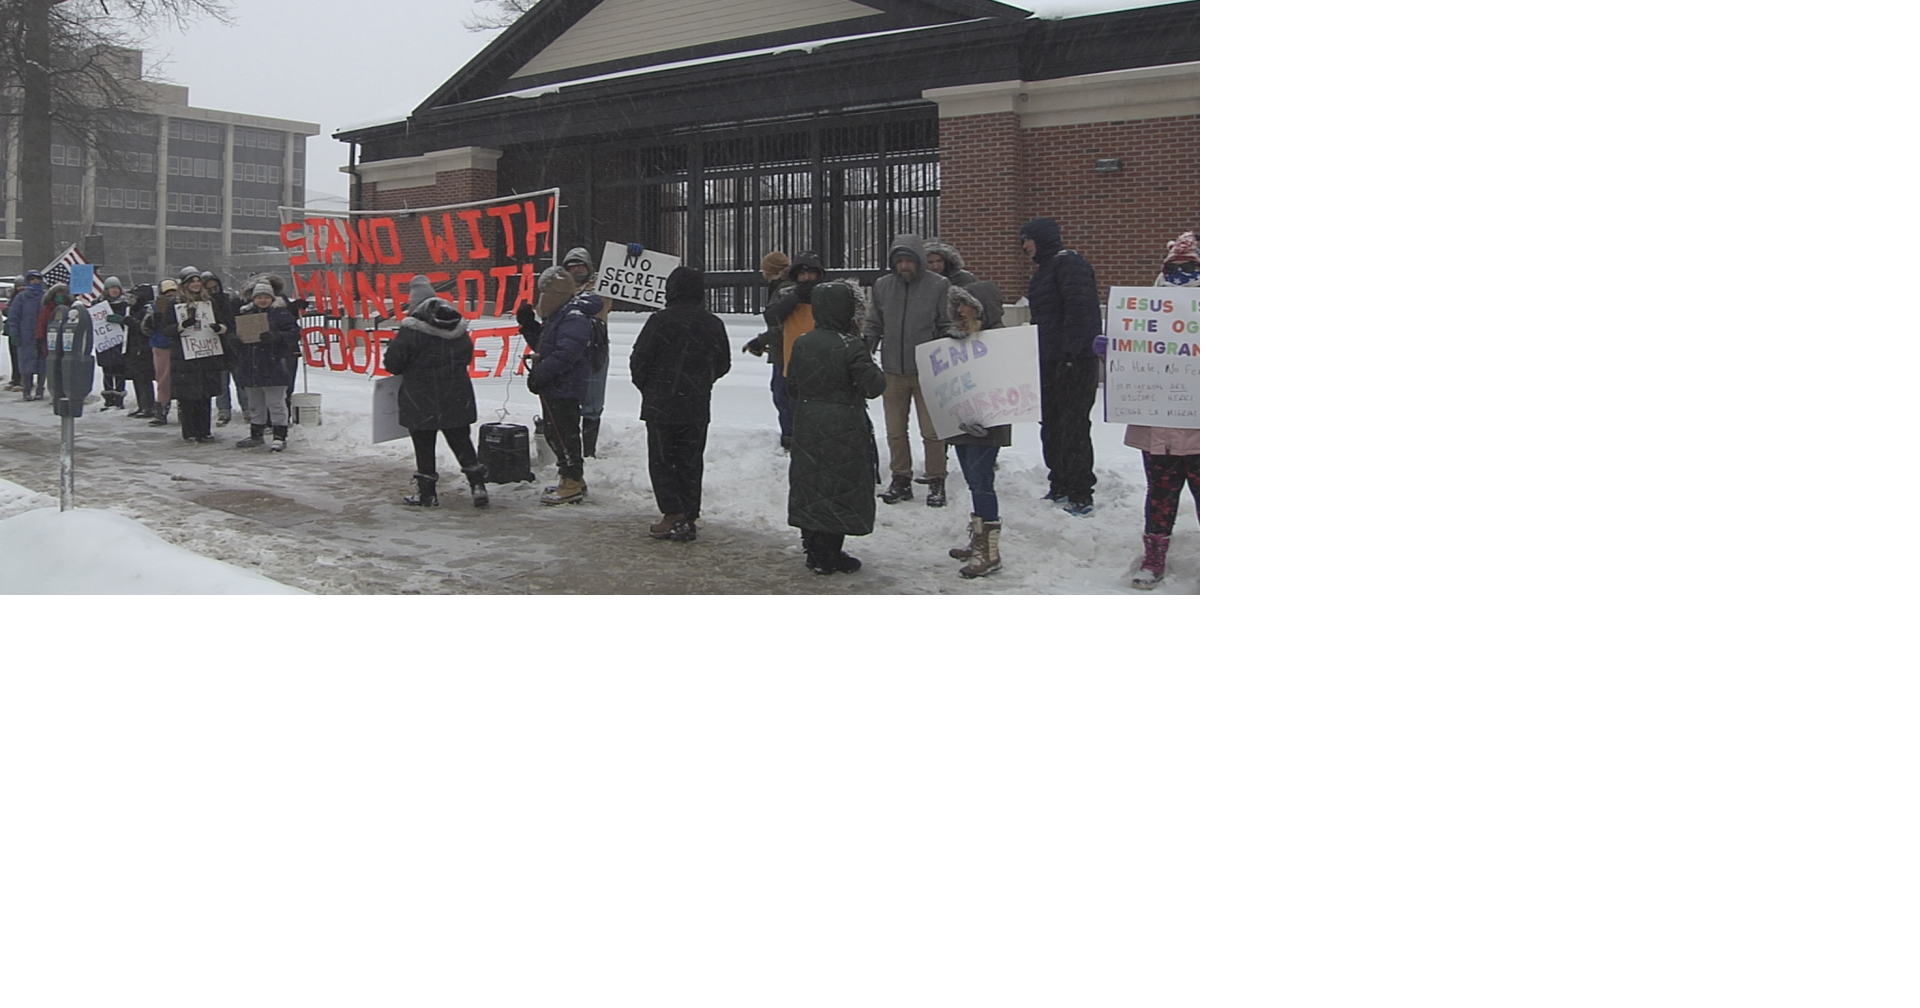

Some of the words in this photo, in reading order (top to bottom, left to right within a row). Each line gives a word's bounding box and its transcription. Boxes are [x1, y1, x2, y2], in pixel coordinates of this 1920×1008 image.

[280, 217, 403, 266] STAND
[421, 196, 555, 264] WITH
[624, 253, 652, 272] NO
[604, 267, 667, 289] SECRET
[598, 280, 666, 304] POLICE
[1116, 297, 1174, 313] JESUS
[1191, 299, 1200, 313] I
[94, 324, 114, 336] ICE
[1122, 318, 1158, 332] THE
[1172, 320, 1199, 334] OG
[98, 334, 124, 351] GOOD
[929, 339, 988, 377] END
[1110, 359, 1125, 373] No
[1165, 363, 1179, 375] No
[935, 371, 976, 408] ICE
